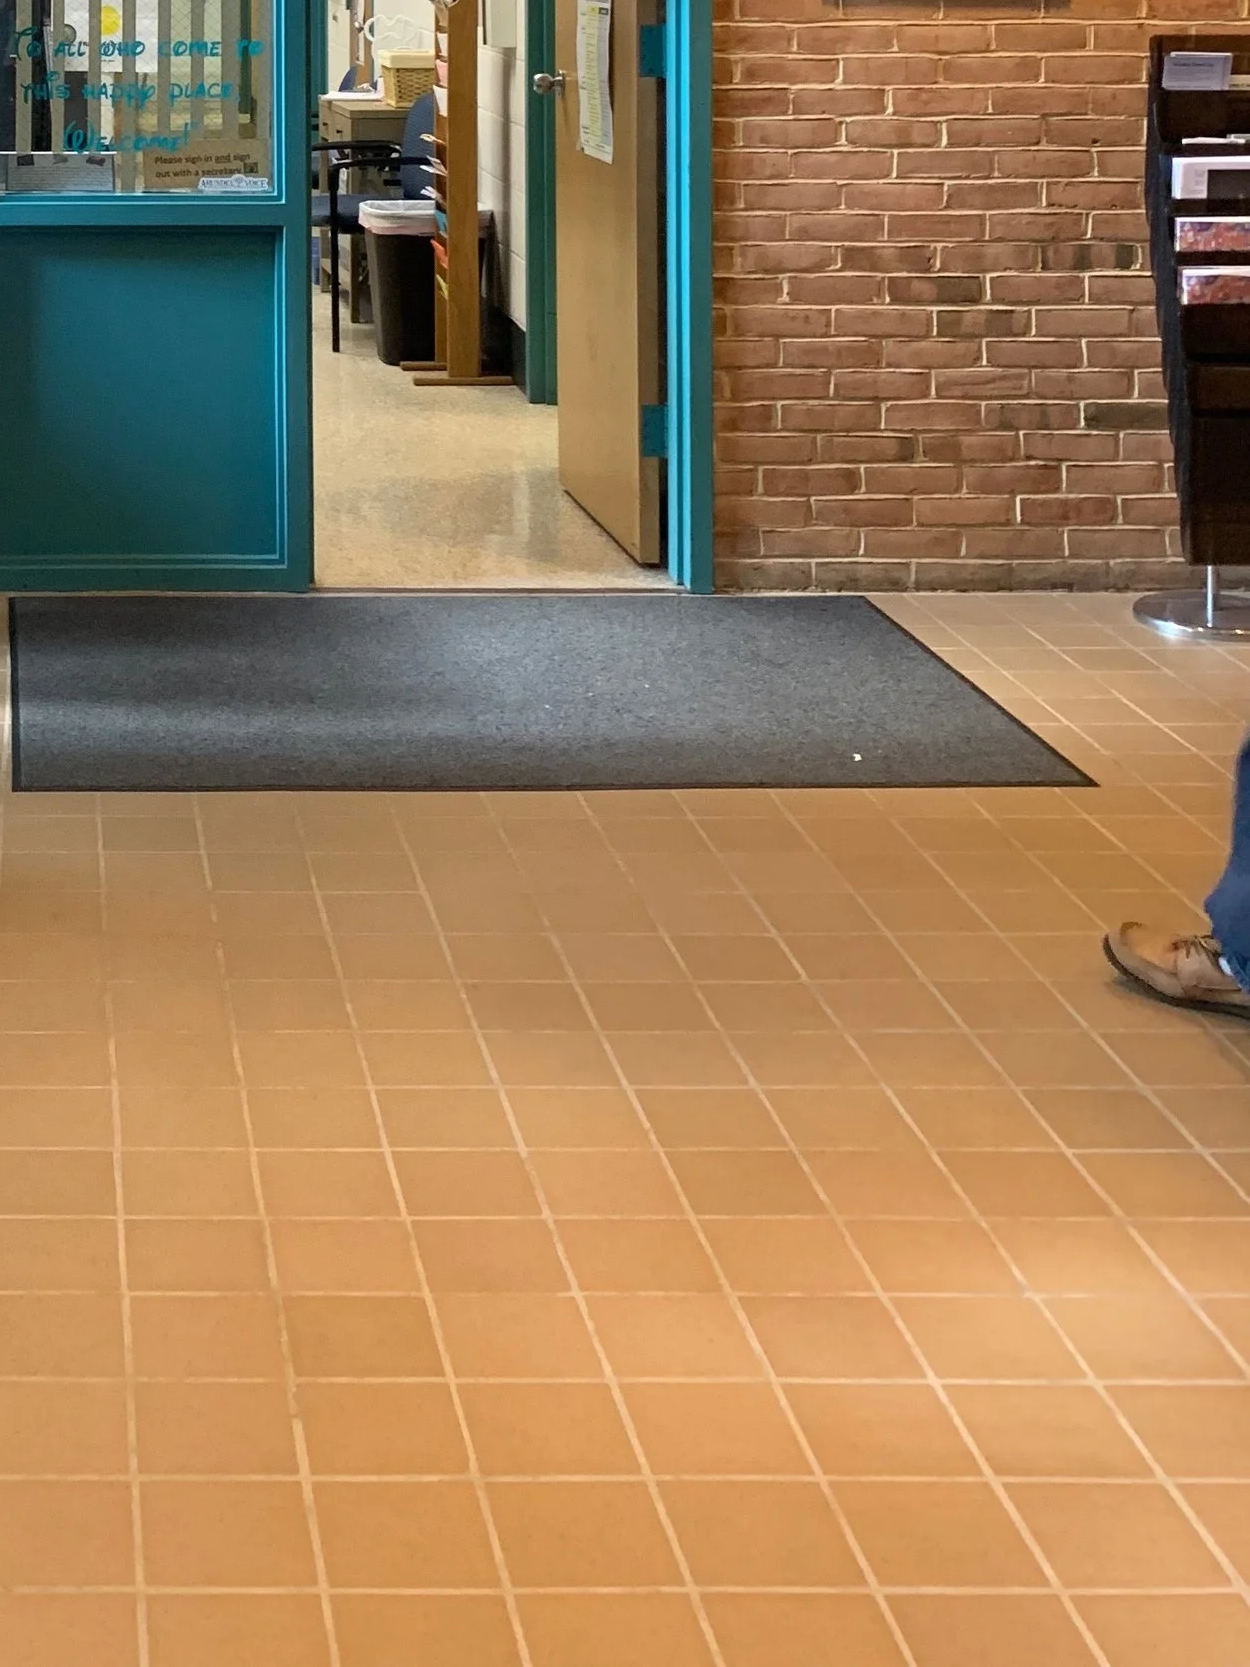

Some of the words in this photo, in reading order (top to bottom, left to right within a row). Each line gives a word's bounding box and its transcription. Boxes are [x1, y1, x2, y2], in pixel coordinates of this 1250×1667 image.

[53, 40, 87, 58] ALL
[100, 40, 146, 58] WHO
[158, 40, 221, 58] COME
[154, 155, 183, 165] Please
[185, 154, 203, 165] sign
[204, 154, 213, 163] in
[214, 153, 231, 163] and
[233, 152, 251, 162] sign
[155, 170, 170, 178] out
[172, 168, 192, 177] with
[193, 169, 200, 177] a
